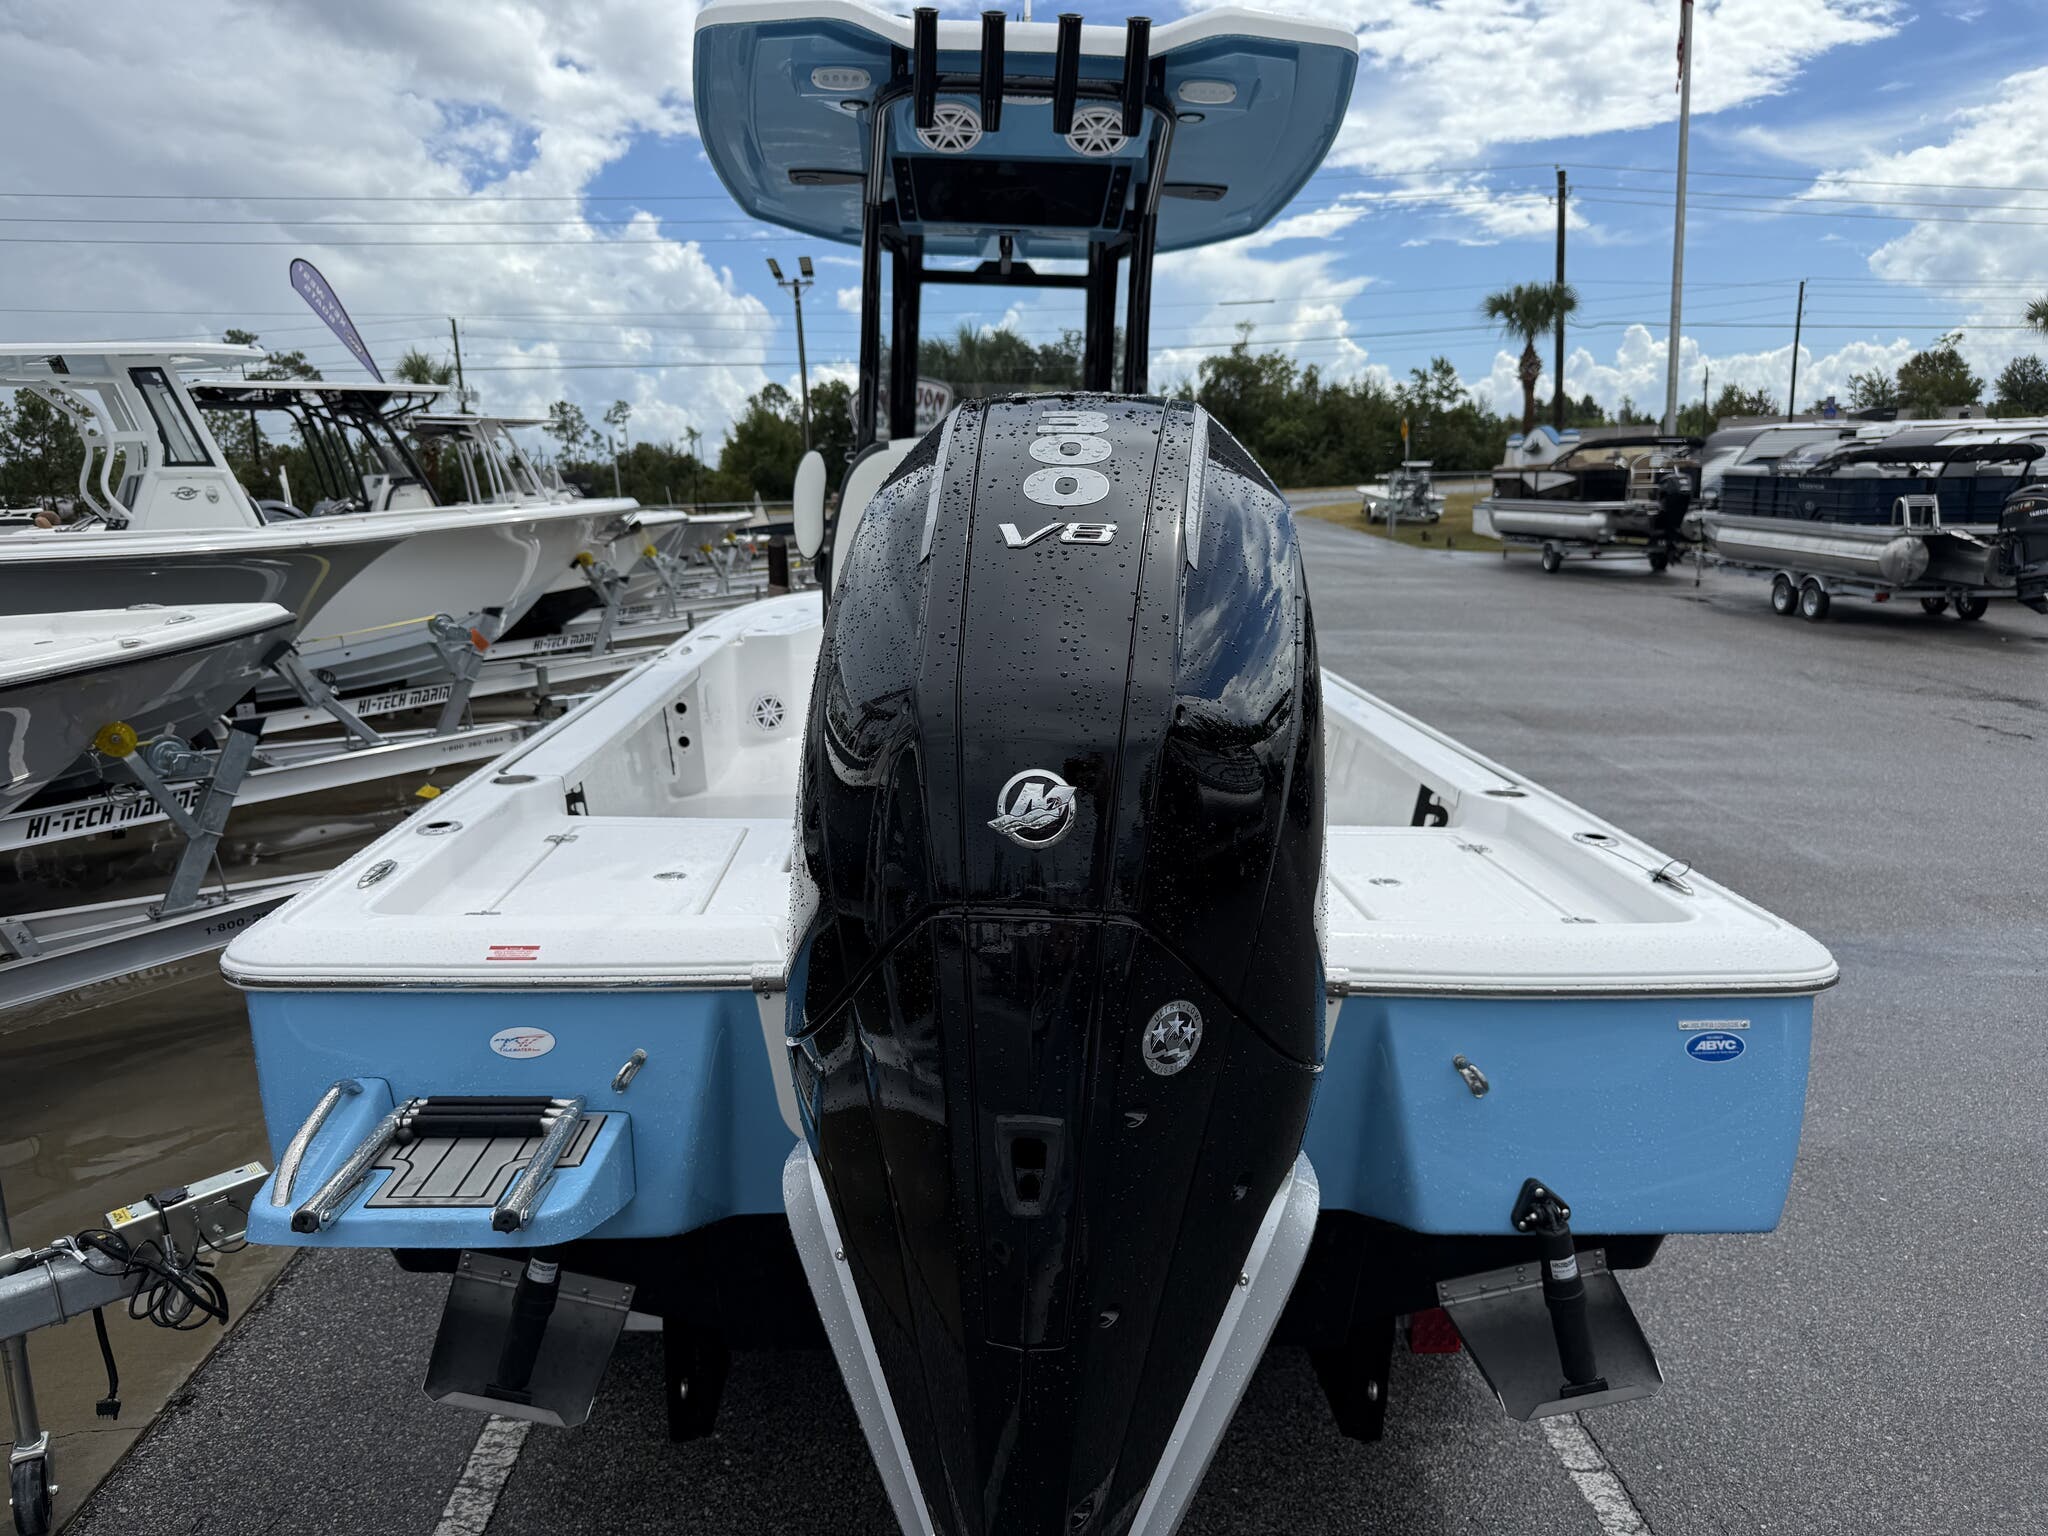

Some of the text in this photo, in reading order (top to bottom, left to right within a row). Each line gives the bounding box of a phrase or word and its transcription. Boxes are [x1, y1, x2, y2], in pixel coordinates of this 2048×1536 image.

[1023, 410, 1112, 507] 300
[999, 522, 1119, 548] V8
[358, 685, 452, 714] HI-TECH MARIN
[26, 788, 201, 840] HI-TECH MANE
[1695, 1040, 1737, 1051] ABYC
